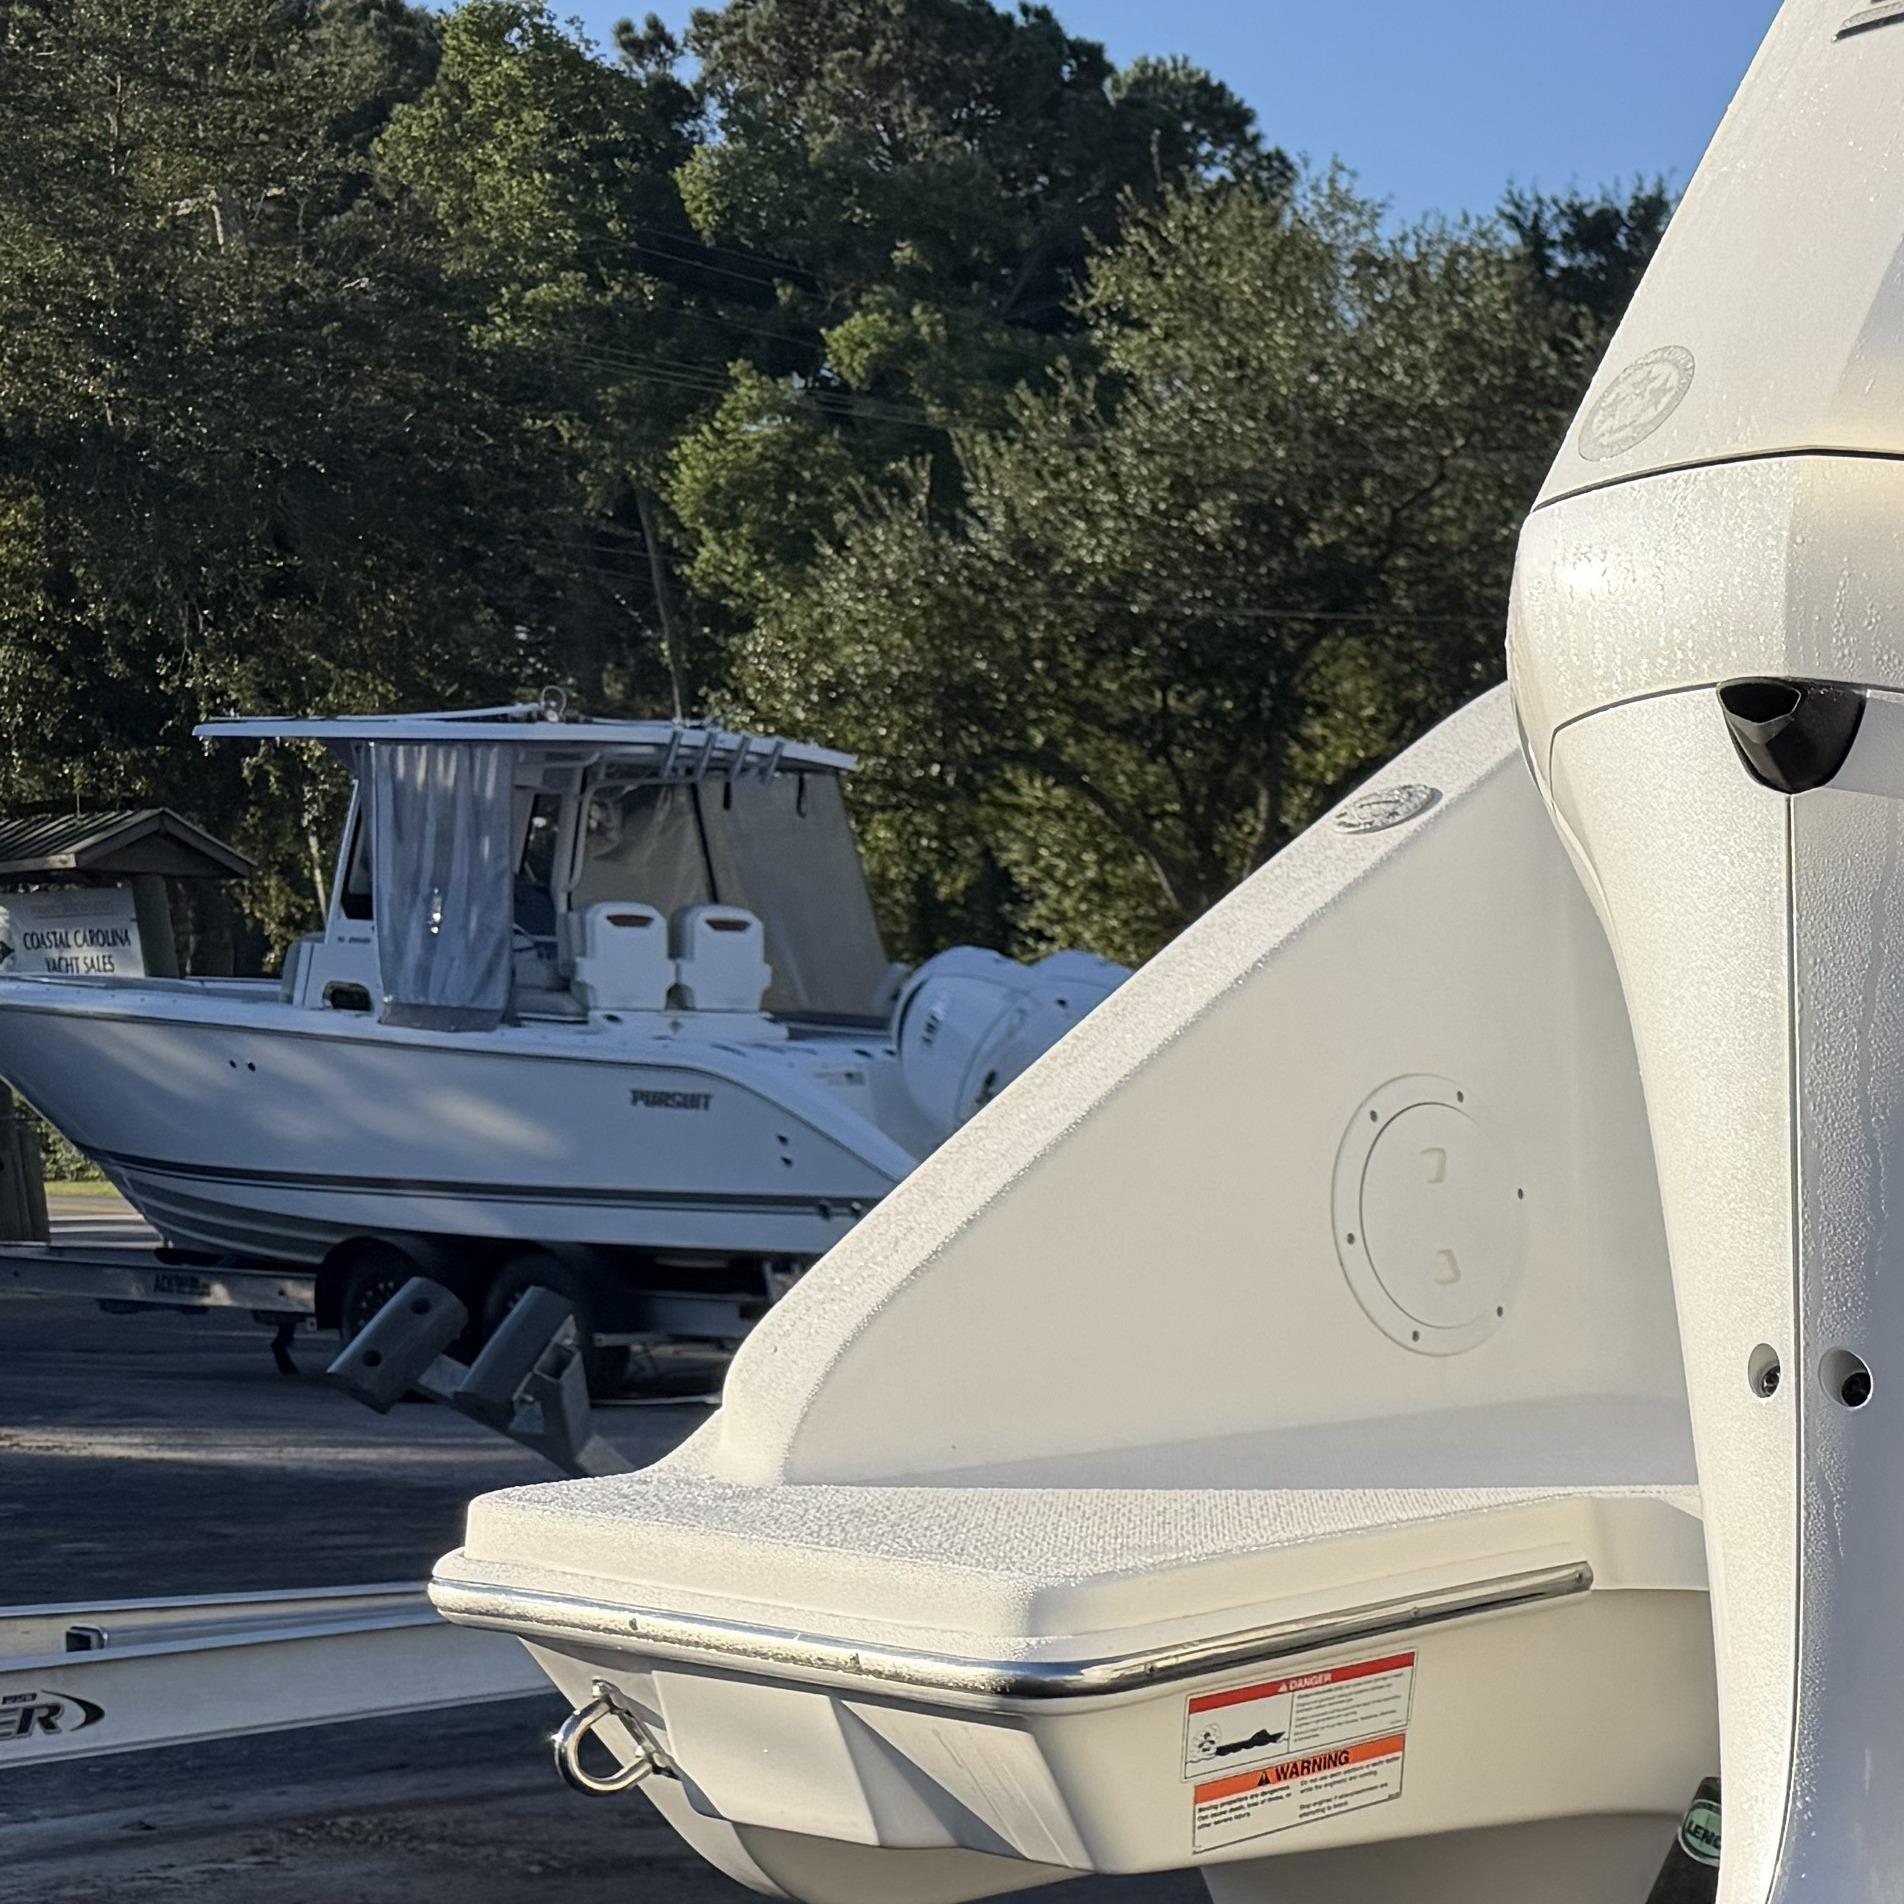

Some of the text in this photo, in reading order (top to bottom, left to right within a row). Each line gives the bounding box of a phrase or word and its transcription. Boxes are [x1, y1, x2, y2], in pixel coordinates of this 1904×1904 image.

[23, 928, 131, 951] COASTAL CAROLINA
[45, 954, 115, 974] YACHT SALES
[1289, 1673, 1332, 1691] DANGER
[1275, 1750, 1350, 1781] WARNING
[1686, 1819, 1722, 1850] LENC
